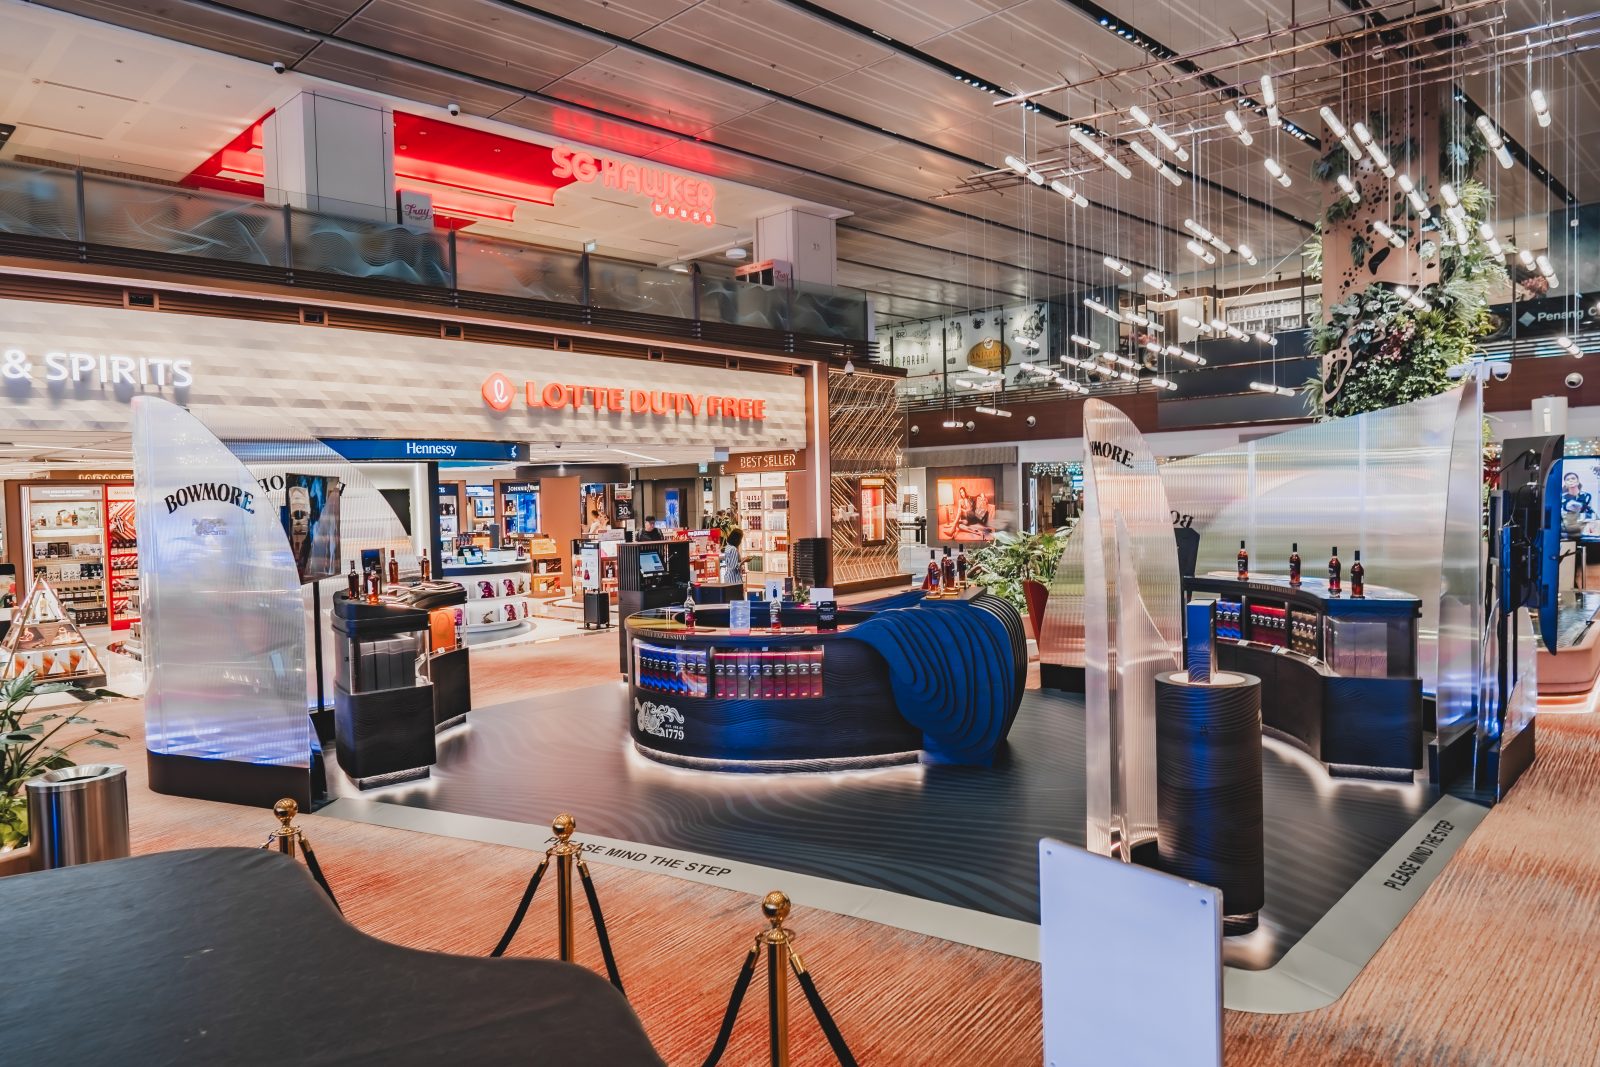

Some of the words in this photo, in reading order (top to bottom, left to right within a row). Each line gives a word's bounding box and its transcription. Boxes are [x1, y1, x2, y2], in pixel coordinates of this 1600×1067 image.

[552, 145, 598, 183] SG
[601, 157, 714, 208] HAWKER
[405, 204, 432, 220] Tray
[1538, 310, 1584, 322] Penang
[2, 350, 32, 379] &
[46, 352, 193, 387] SPIRITS
[525, 381, 625, 411] LOTTE
[630, 389, 703, 415] DUTY
[706, 395, 767, 420] FREE
[406, 442, 457, 456] Hennessy
[1091, 441, 1134, 468] MORE
[740, 456, 762, 469] BEST
[764, 453, 796, 468] SELLER
[164, 482, 255, 515] BOWMORE
[665, 728, 685, 740] 1779
[1431, 820, 1455, 837] STEP
[1420, 834, 1445, 848] THE
[604, 847, 648, 862] MIND
[649, 855, 685, 869] THE
[684, 862, 732, 877] STEP
[1407, 845, 1434, 865] MIND
[1383, 861, 1420, 891] PLEASE
